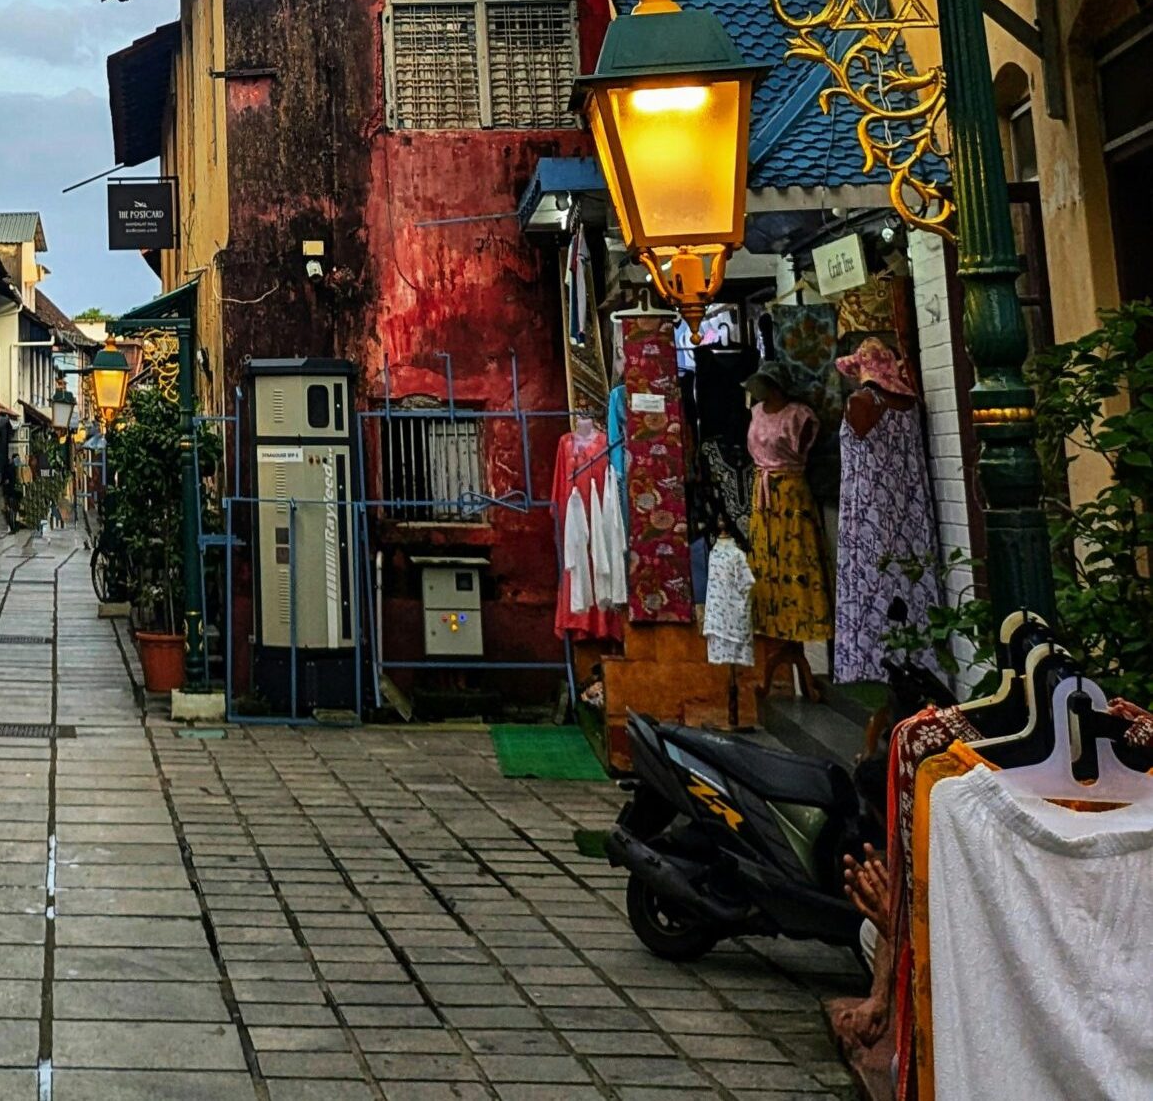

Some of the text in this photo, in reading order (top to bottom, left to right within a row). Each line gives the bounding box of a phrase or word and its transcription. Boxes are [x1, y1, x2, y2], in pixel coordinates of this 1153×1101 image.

[118, 210, 164, 219] THE POSTCARD
[686, 774, 745, 833] ZR
